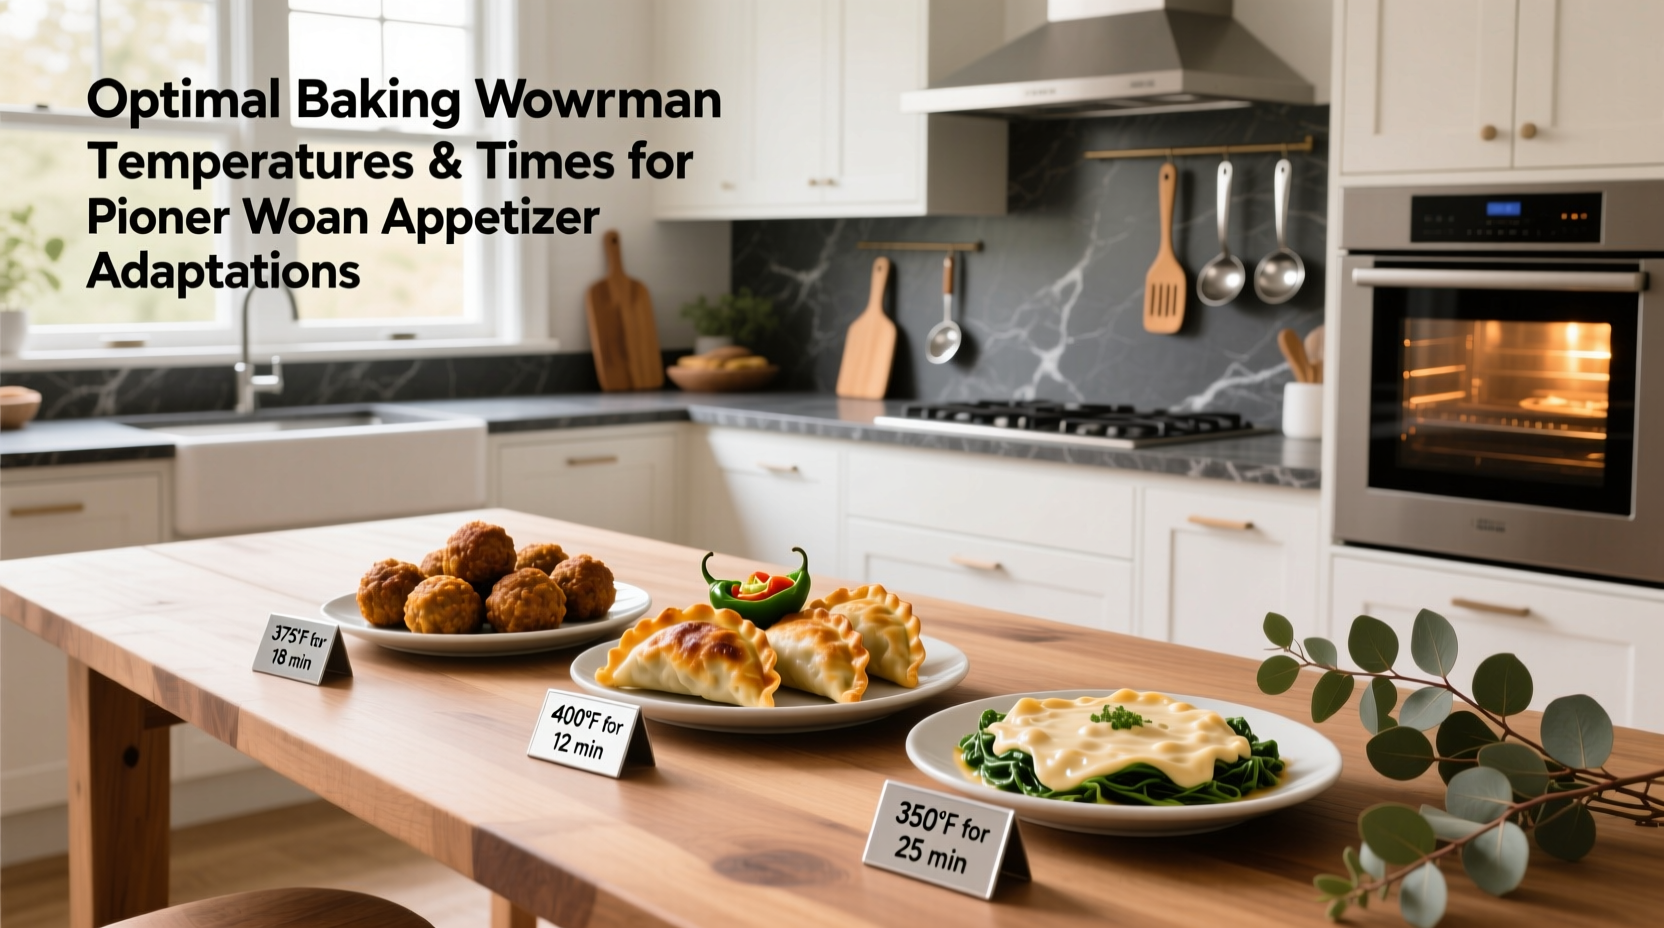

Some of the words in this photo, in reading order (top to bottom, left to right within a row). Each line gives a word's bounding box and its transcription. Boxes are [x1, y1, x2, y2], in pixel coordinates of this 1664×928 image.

[272, 648, 287, 665] 18
[288, 653, 311, 671] min
[601, 715, 624, 735] for
[553, 731, 572, 753] 12
[573, 740, 604, 760] min
[895, 801, 960, 835] 350°F
[961, 818, 991, 843] for
[894, 835, 925, 862] 25
[927, 848, 967, 875] min
